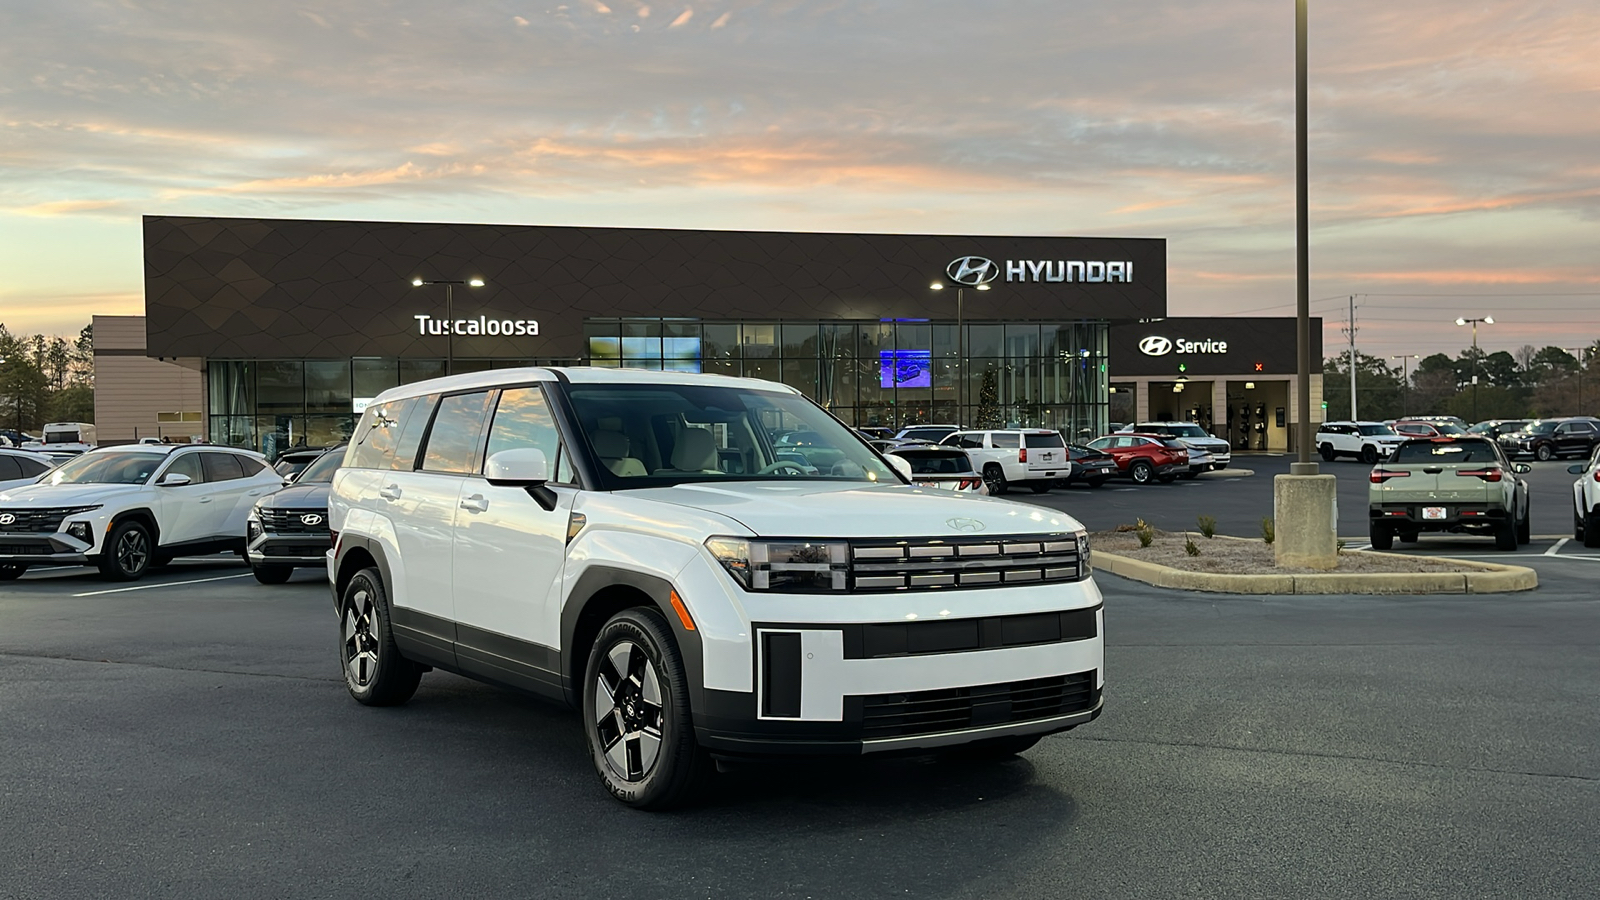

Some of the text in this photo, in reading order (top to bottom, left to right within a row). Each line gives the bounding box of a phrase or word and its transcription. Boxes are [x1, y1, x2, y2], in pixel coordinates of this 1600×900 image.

[1006, 260, 1133, 282] HYUNDAI
[414, 315, 539, 335] Tuscaloosa
[1176, 338, 1228, 353] Service
[600, 770, 636, 800] NEXEN
